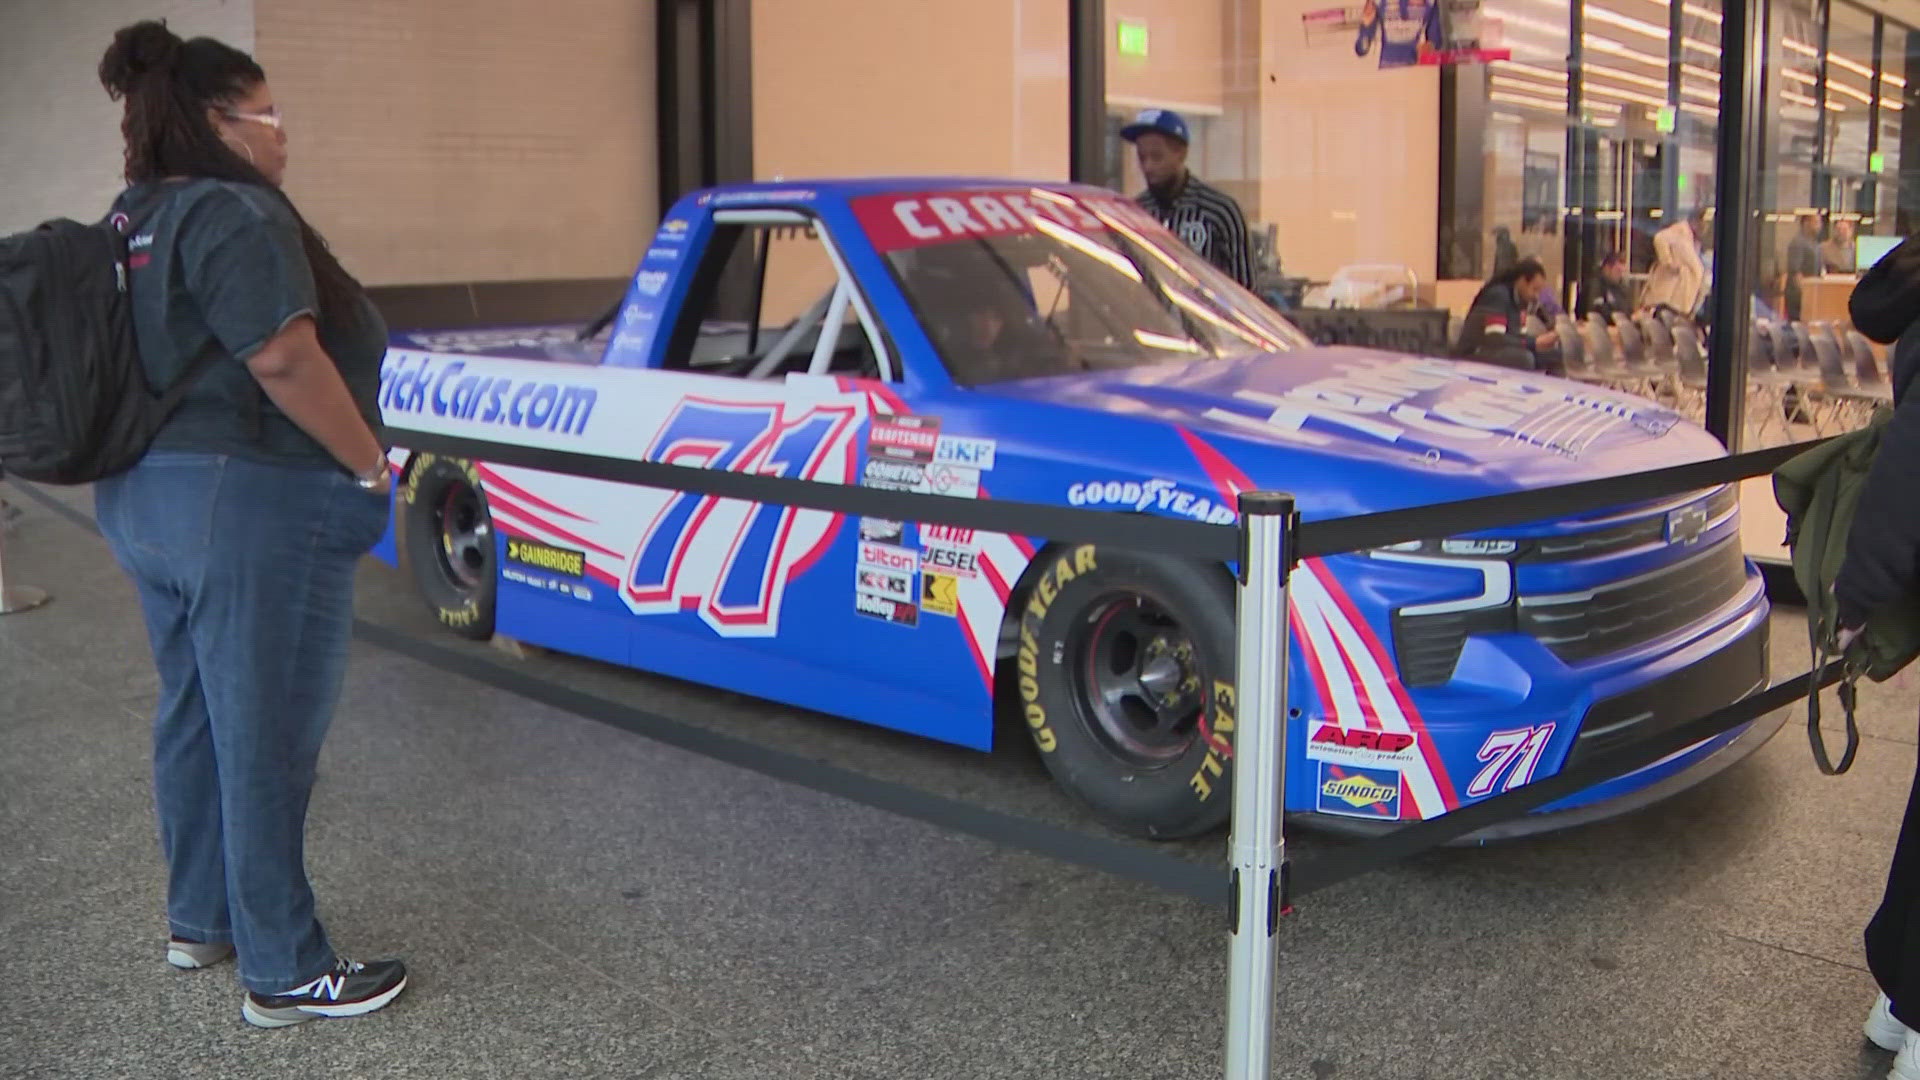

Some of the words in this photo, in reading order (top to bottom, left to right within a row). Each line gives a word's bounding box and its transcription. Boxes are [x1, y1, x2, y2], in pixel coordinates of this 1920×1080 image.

[936, 439, 991, 462] SKF
[627, 394, 856, 627] 71
[1068, 478, 1236, 525] GOODYEAR
[519, 543, 582, 576] GAINBRIDGE
[863, 546, 914, 570] tilton
[921, 546, 977, 572] JESEL
[1018, 544, 1098, 753] GOODYEAR
[1311, 725, 1415, 753] ARP
[1376, 753, 1414, 763] products
[1467, 722, 1556, 797] 71
[1324, 780, 1396, 802] SUNOCO
